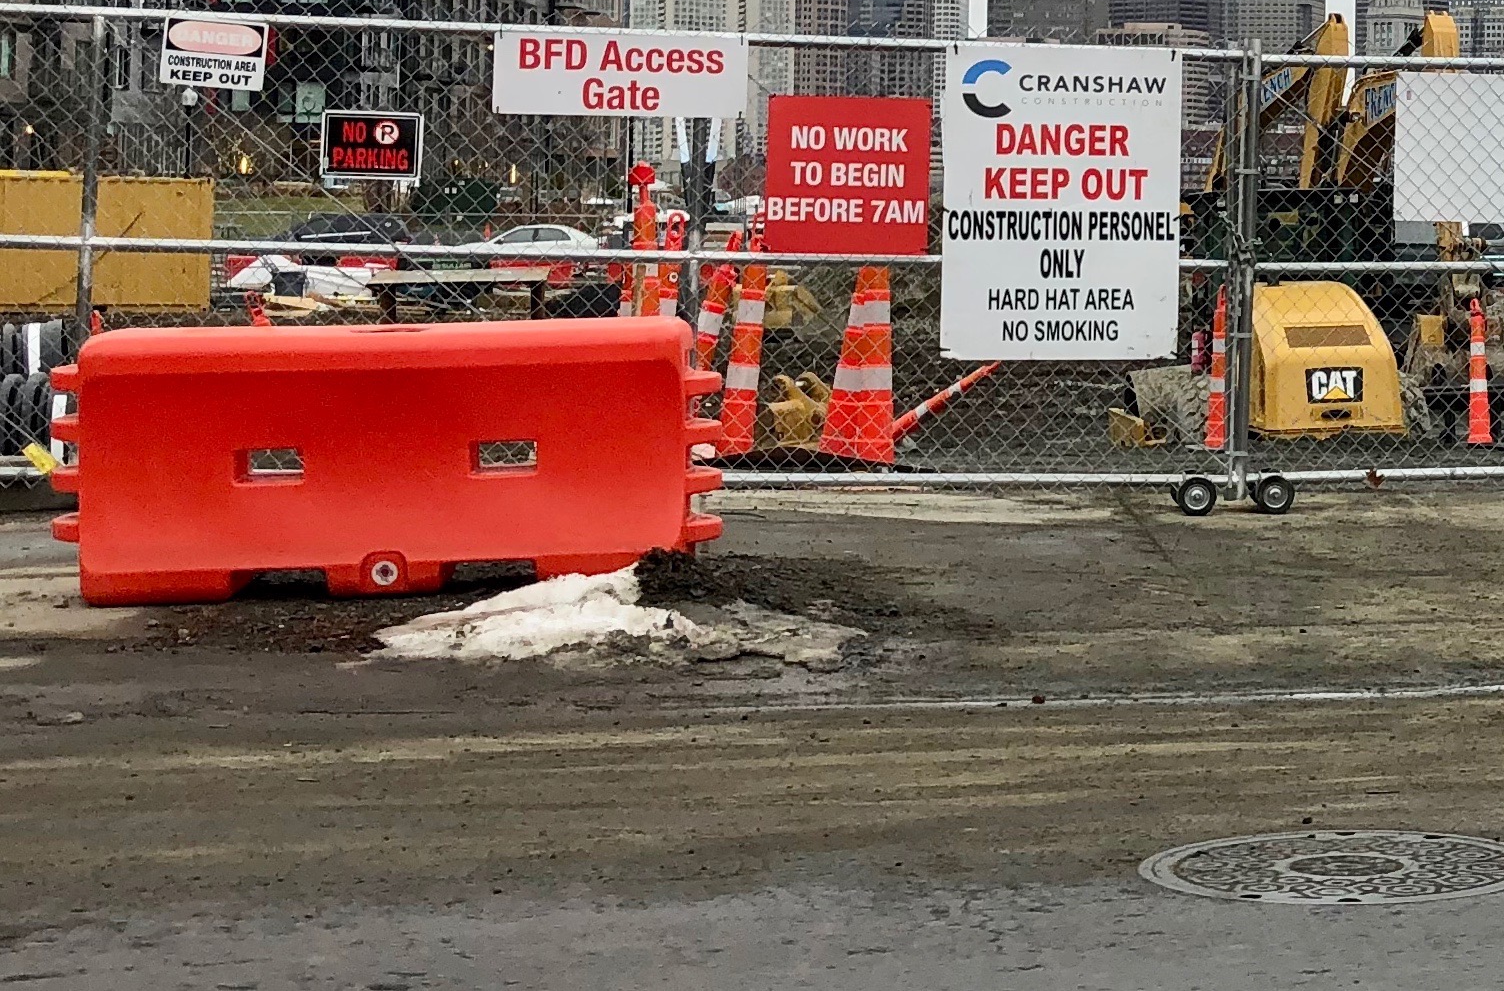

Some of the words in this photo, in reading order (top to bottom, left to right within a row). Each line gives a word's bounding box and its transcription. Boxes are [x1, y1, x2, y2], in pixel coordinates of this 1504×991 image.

[167, 55, 232, 71] CONSTRUCTION
[233, 61, 257, 72] AREA
[518, 38, 588, 70] BFD
[599, 40, 724, 74] Access
[169, 69, 213, 82] KEEP
[218, 73, 252, 86] OUT
[1019, 74, 1167, 94] CRANSHAW
[582, 77, 660, 111] Gate
[1021, 97, 1163, 107] CONSTRUCTION
[342, 121, 367, 143] NO
[791, 125, 826, 150] NO
[833, 126, 908, 152] WORK
[996, 123, 1129, 156] DANGER
[332, 146, 409, 170] PARKING
[790, 161, 823, 186] TO
[830, 162, 905, 188] BEGIN
[984, 167, 1070, 200] KEEP
[1081, 167, 1148, 201] OUT
[767, 196, 863, 223] BEFORE
[870, 199, 925, 224] 7AM
[948, 210, 1083, 241] CONSTRUCTION
[1088, 211, 1175, 241] PERSONEL
[1040, 248, 1085, 279] ONLY
[988, 288, 1039, 311] HARD
[1045, 288, 1080, 311] HAT
[1085, 288, 1134, 311] AREA
[1002, 320, 1029, 342] NO
[1034, 320, 1119, 342] SMOKING
[1311, 370, 1357, 400] CAT
